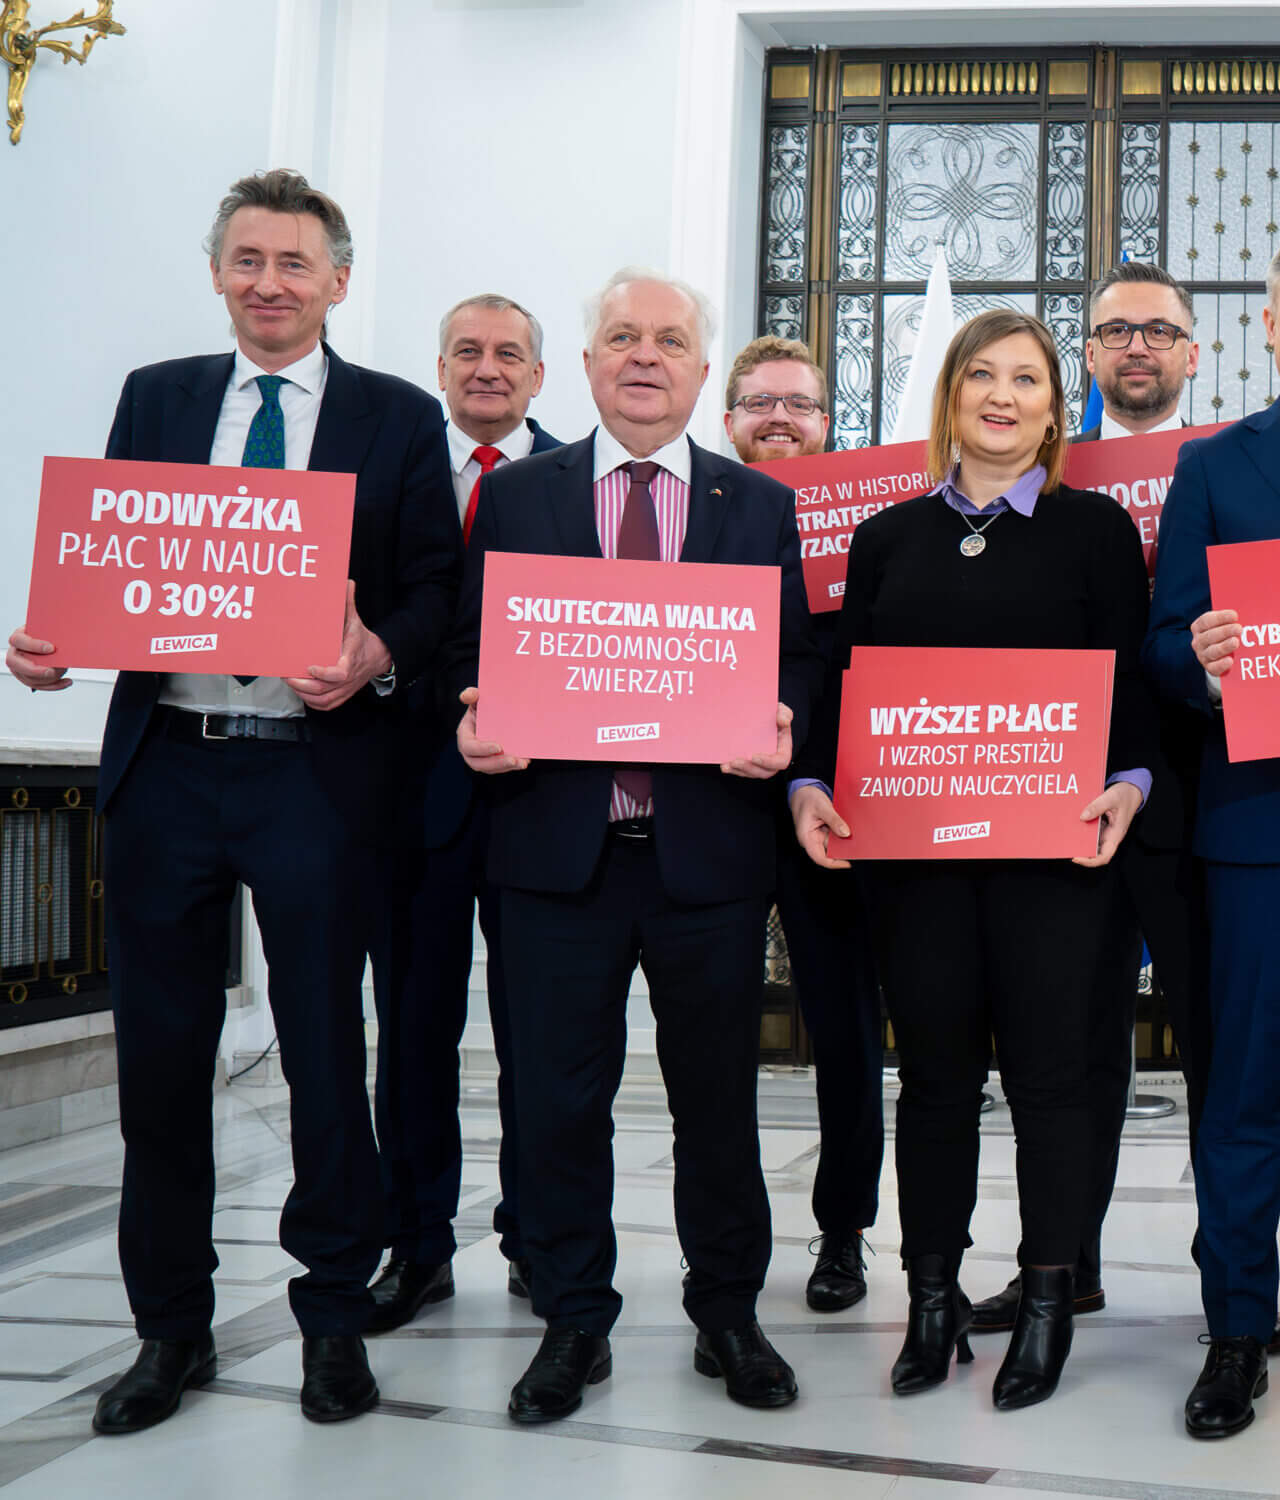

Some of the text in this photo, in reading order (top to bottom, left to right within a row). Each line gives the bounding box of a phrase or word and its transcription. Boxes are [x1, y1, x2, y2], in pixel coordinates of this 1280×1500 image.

[90, 485, 302, 533] PODWYŻKA
[794, 487, 832, 507] SZA
[836, 482, 853, 501] W
[1085, 475, 1174, 510] OCN
[58, 531, 319, 578] PŁAC W NAUCE
[123, 580, 255, 620] O 30%!
[506, 595, 756, 631] SKUTECZNA WALKA
[154, 636, 214, 652] LEWICA
[515, 630, 738, 670] Z BEZDOMNOŚCIĄ
[565, 666, 694, 701] ZWIERZĄT!
[601, 724, 657, 741] LEWICA
[870, 697, 1078, 736] WYŻSZE PŁACE
[879, 737, 1063, 766] I WZROST PRESTIŻU
[860, 773, 1079, 797] ZAWODU NAUCZYCIELA
[937, 824, 988, 841] LEWICA
